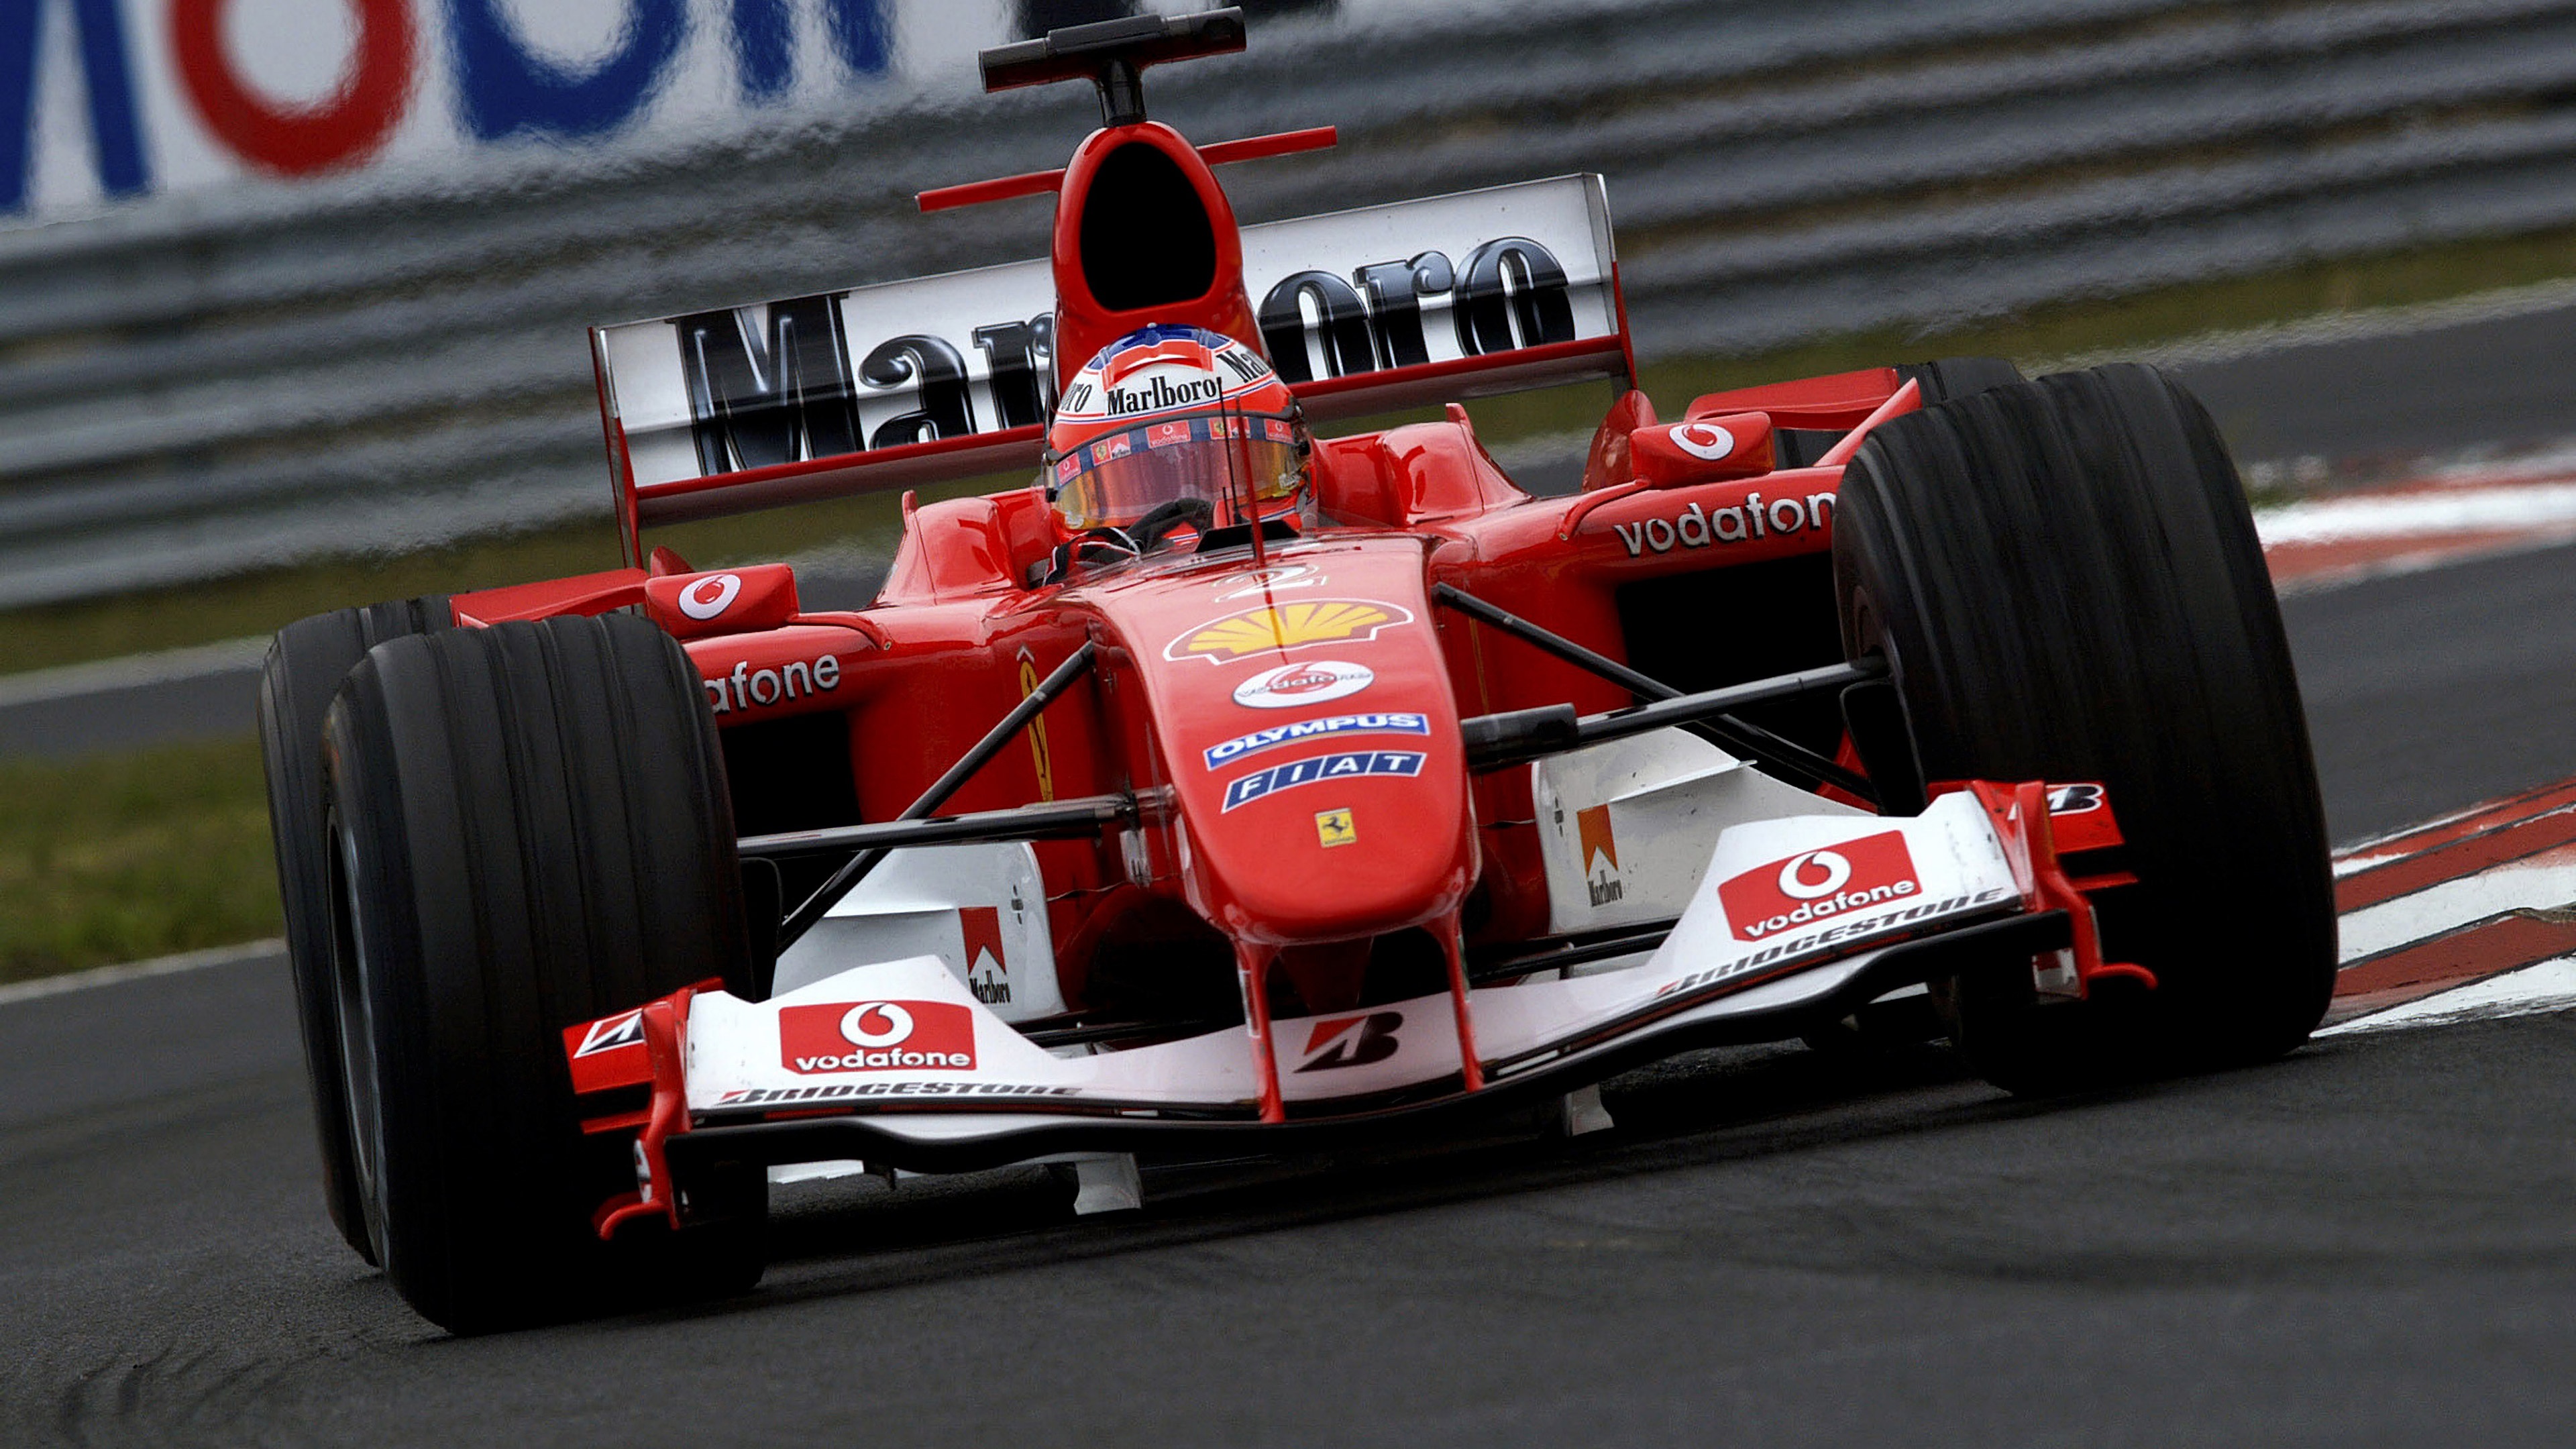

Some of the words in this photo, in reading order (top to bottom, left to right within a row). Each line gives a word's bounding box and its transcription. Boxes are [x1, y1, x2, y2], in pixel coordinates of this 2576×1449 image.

[1107, 376, 1216, 415] Marlboro
[1613, 492, 1837, 555] vodafon
[704, 655, 839, 714] afone
[1212, 715, 1420, 759] OLYMPUS
[1239, 755, 1411, 801] FIAT
[1745, 880, 1917, 938] vodafone
[1657, 888, 2004, 999] BRIDGESTONE
[796, 1049, 971, 1071] vodafone
[716, 1082, 1081, 1104] BRIDGESTONE
